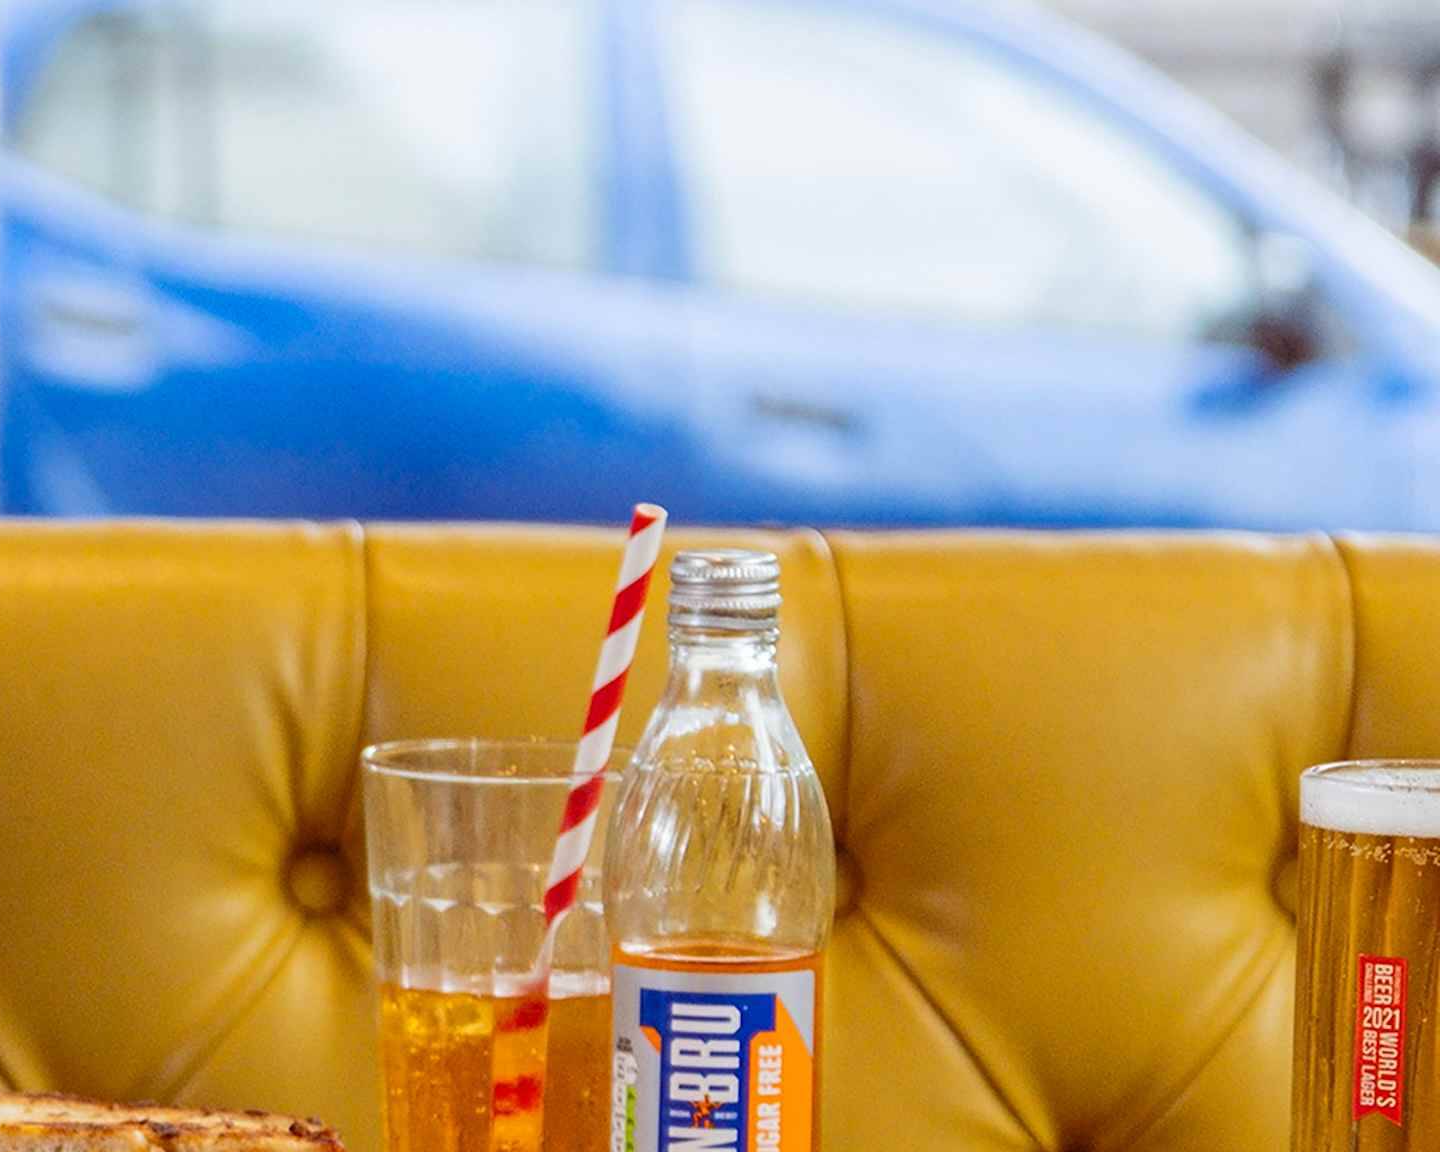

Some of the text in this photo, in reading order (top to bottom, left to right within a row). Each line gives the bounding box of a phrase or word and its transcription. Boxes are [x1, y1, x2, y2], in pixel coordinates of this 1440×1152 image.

[1373, 963, 1394, 1005] BEER
[1363, 1006, 1401, 1030] 2021
[757, 1043, 783, 1096] FREE
[1360, 1029, 1378, 1106] BEST LAGER
[1376, 1031, 1399, 1108] WORLD'S
